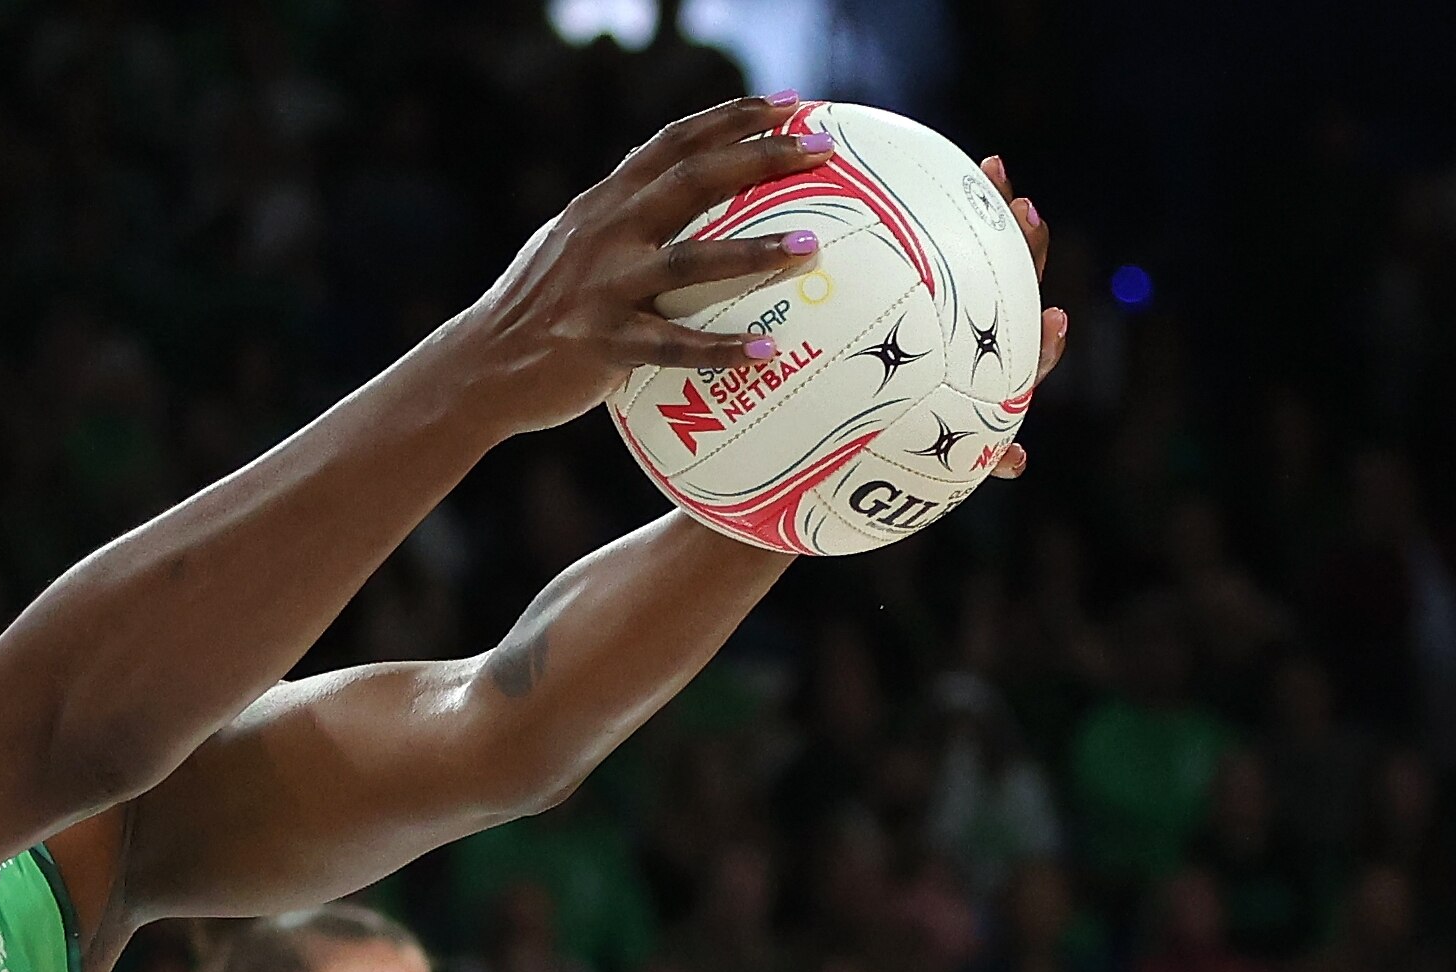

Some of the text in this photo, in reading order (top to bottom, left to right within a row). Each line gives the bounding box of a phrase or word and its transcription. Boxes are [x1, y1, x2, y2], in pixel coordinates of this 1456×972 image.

[697, 300, 791, 384] SORP
[709, 350, 783, 405] SUP
[722, 340, 823, 424] NETBALL
[848, 480, 941, 530] GIL
